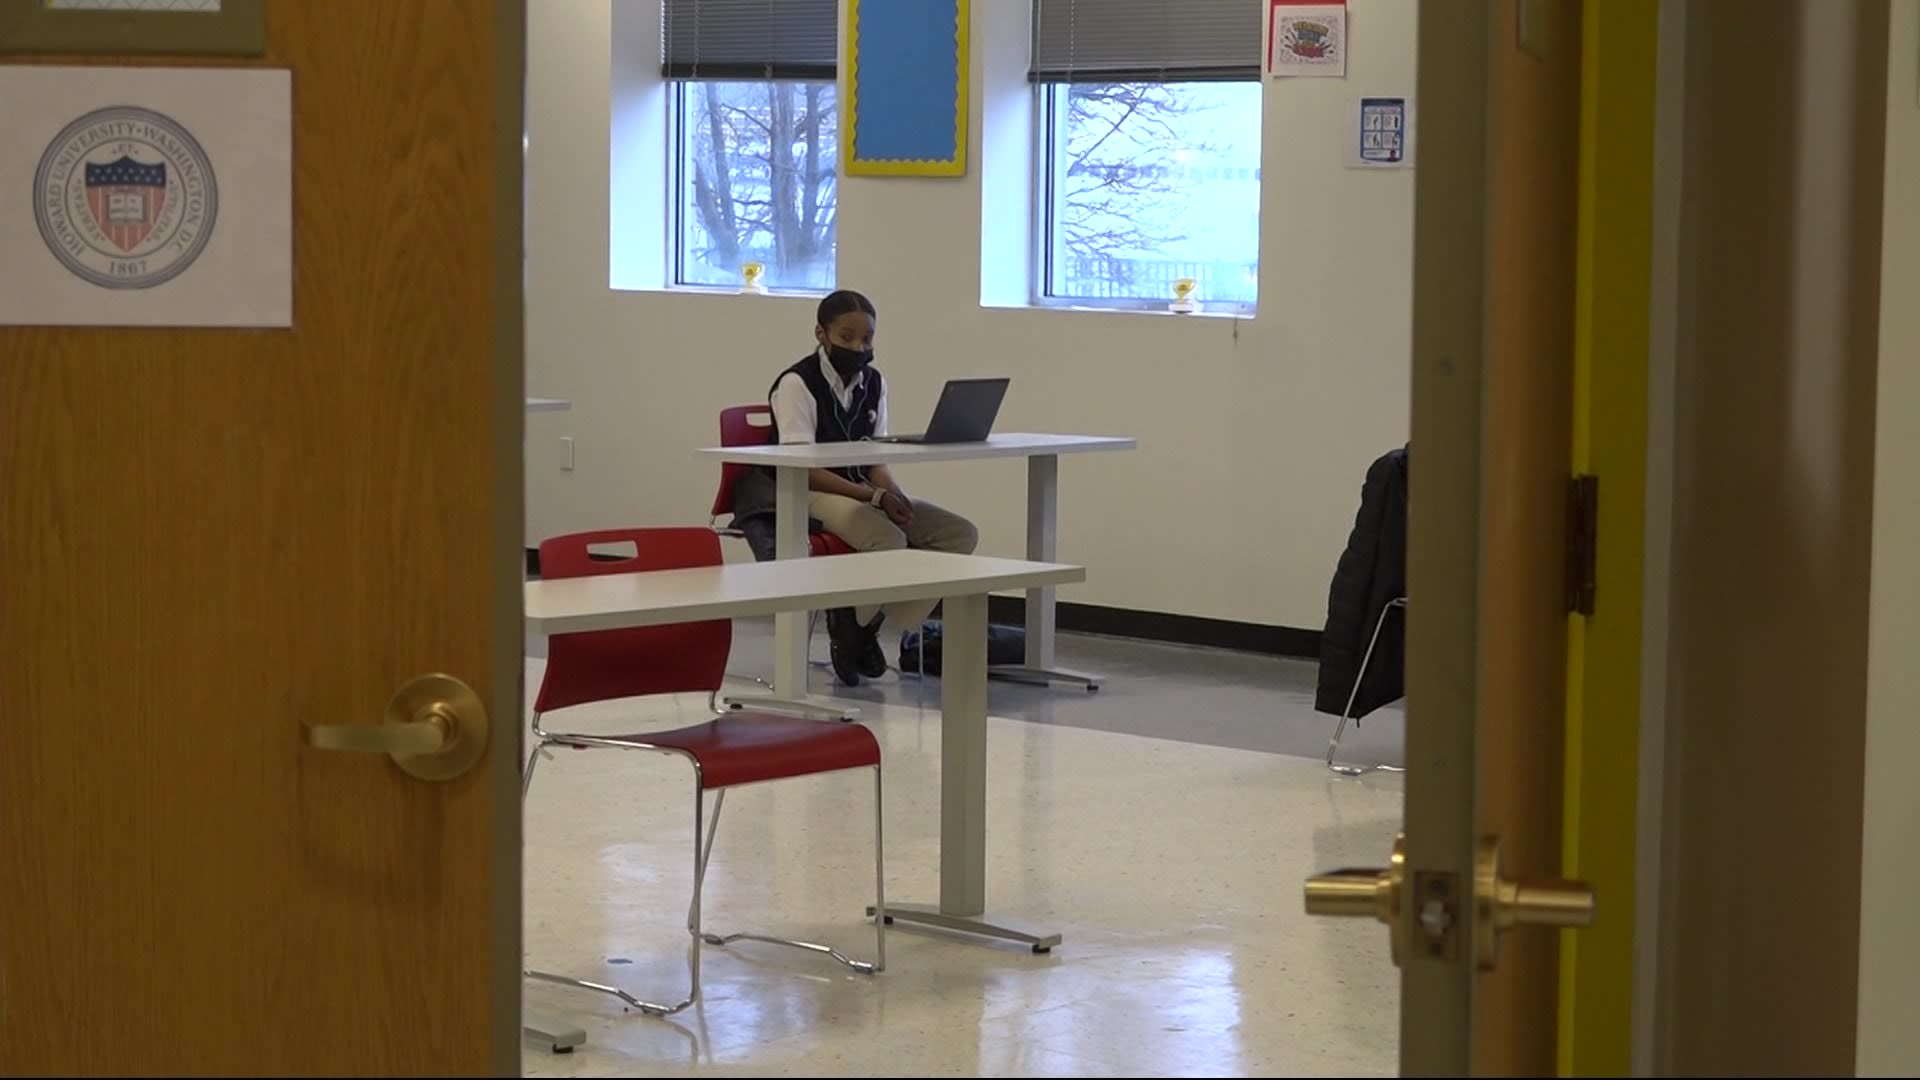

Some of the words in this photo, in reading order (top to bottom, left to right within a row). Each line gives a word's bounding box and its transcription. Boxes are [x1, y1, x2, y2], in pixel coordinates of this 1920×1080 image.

[52, 122, 136, 180] UNIVERSITY
[144, 125, 201, 225] WASHINGTON
[48, 185, 85, 256] HOWARD
[109, 260, 147, 274] 1867
